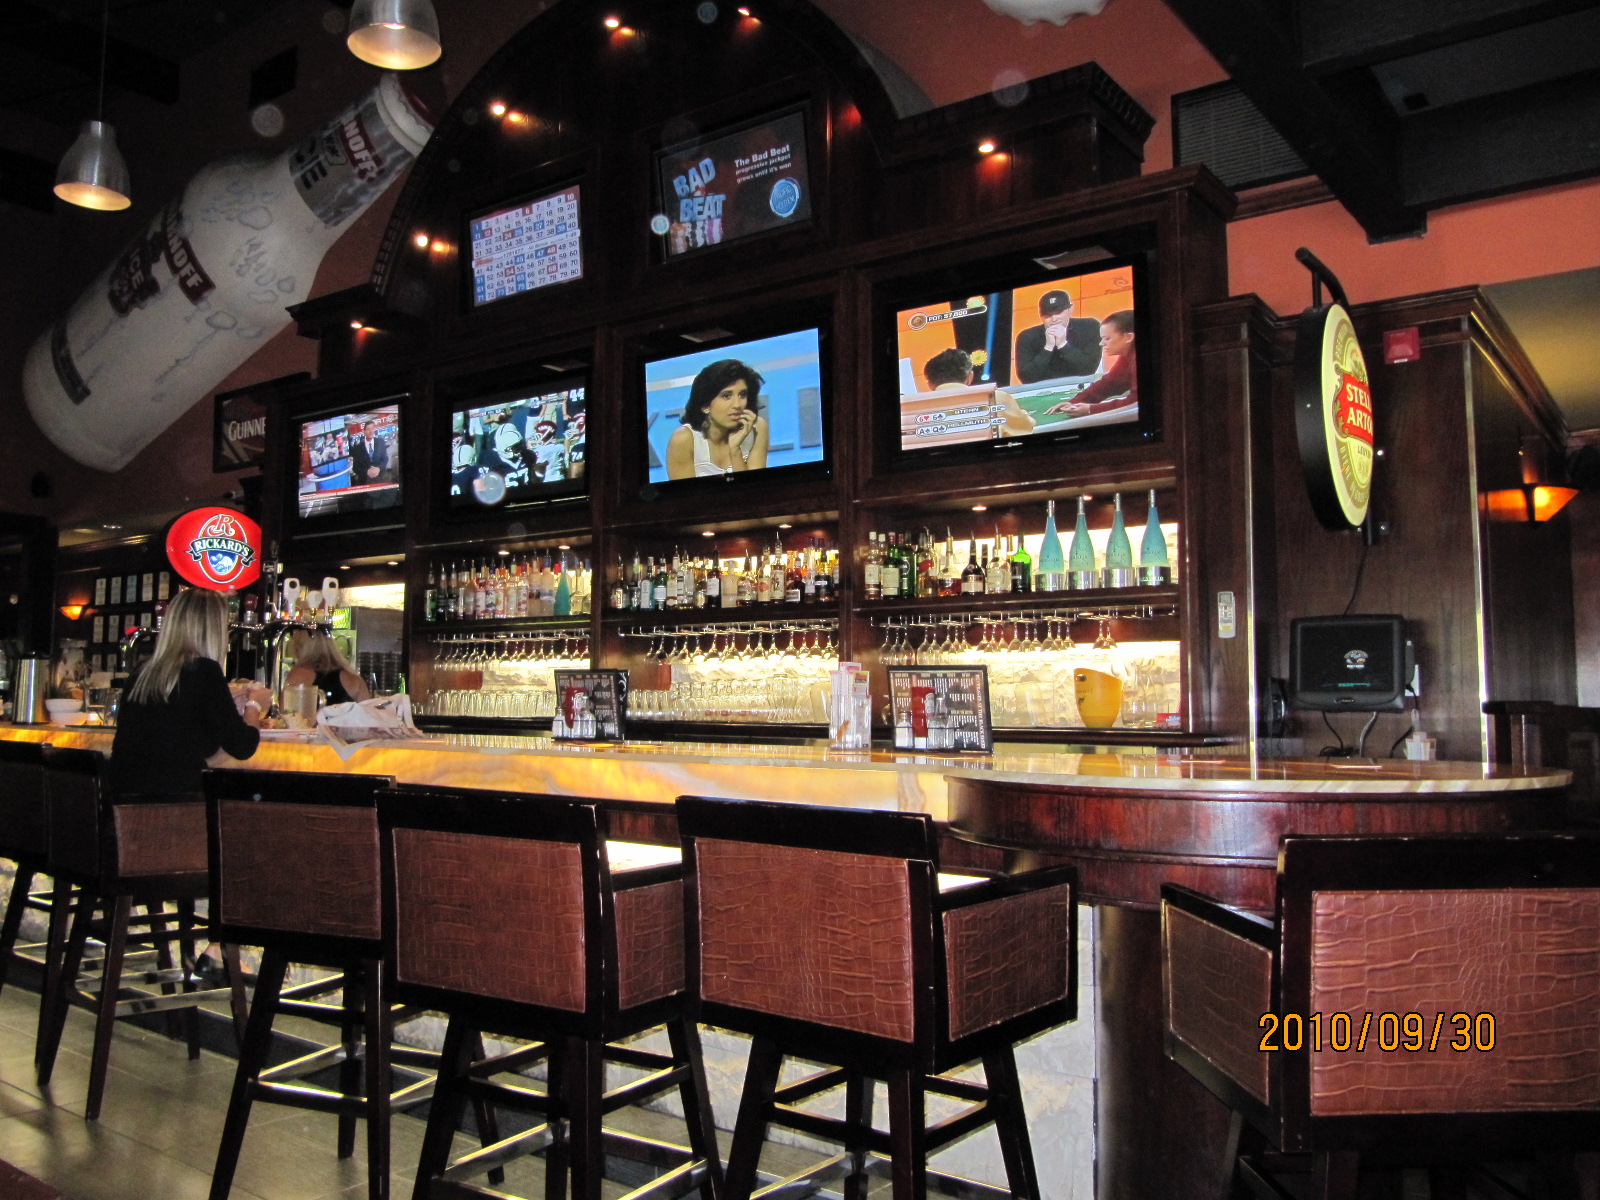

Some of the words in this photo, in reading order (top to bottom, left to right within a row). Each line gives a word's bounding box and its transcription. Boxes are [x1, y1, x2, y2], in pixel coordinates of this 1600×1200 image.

[735, 159, 750, 168] The
[752, 151, 768, 162] Bad
[770, 144, 790, 156] Beat
[672, 158, 716, 197] BAD
[680, 194, 726, 222] BEAT
[1346, 383, 1372, 412] STELL
[228, 416, 266, 442] GUINNE
[1346, 406, 1373, 436] ARTO
[207, 514, 236, 536] R
[195, 538, 250, 556] RICKARD'S
